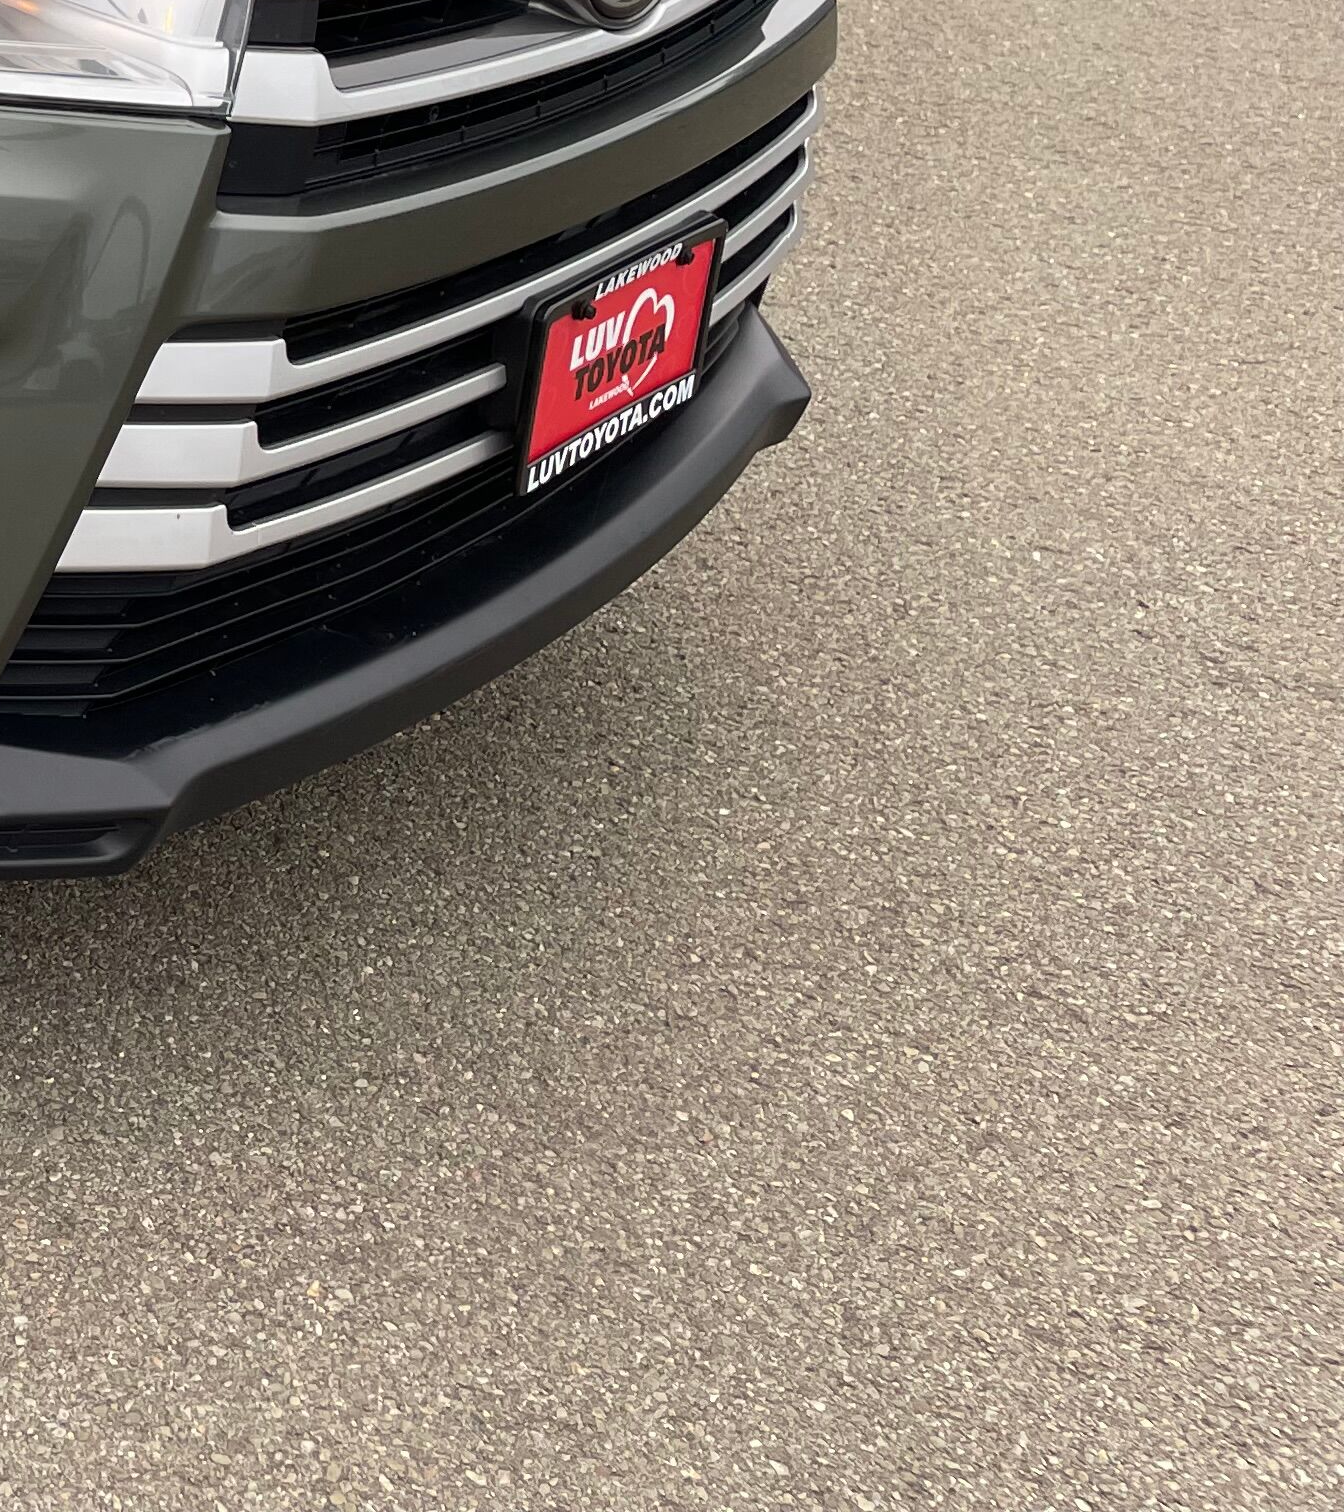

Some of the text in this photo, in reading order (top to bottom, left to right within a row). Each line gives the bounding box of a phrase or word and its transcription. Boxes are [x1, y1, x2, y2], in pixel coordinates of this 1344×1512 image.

[595, 243, 684, 302] LAKEWOOD
[569, 310, 627, 371] LUV
[574, 324, 666, 400] TOYOTA
[526, 374, 696, 493] LUVTOYOTA.COM
